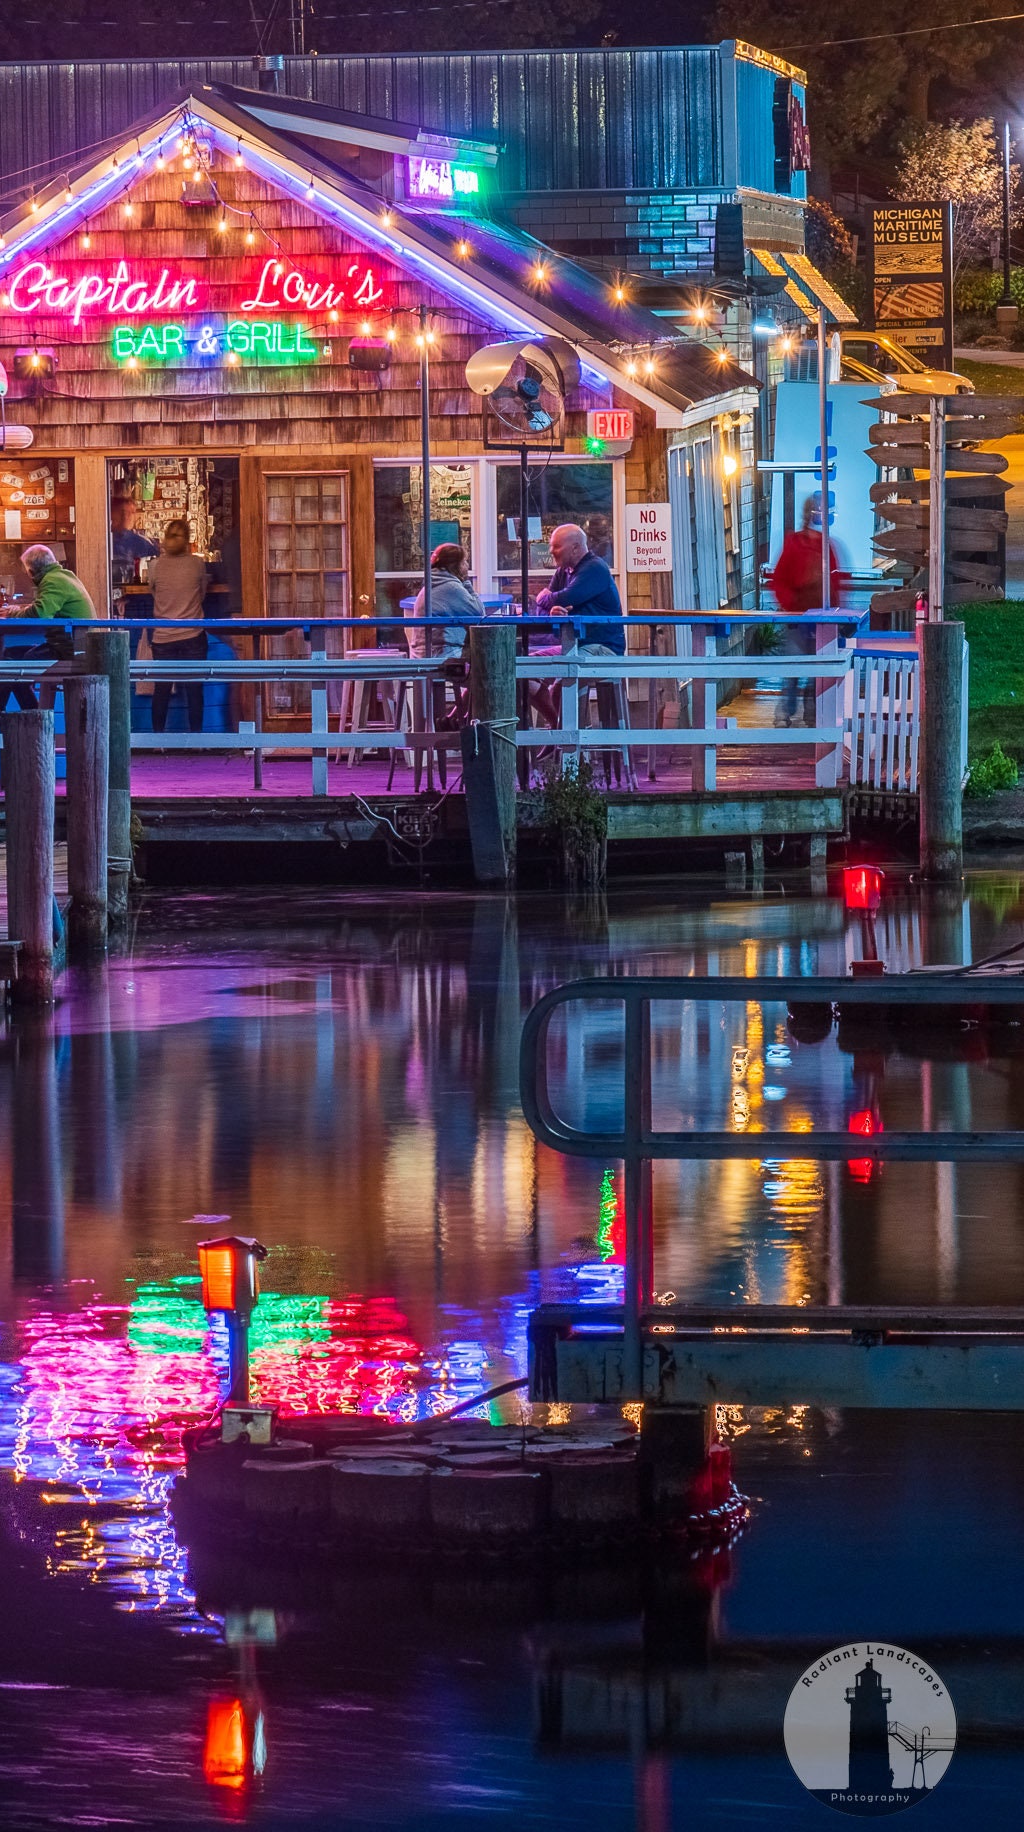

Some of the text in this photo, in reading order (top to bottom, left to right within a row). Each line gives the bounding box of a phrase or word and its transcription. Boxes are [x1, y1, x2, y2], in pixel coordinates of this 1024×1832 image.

[873, 208, 942, 220] MICHIGAN
[873, 220, 943, 231] MARITIME
[873, 231, 943, 243] MUSEUM
[10, 258, 383, 326] Captain Lou's
[115, 321, 315, 356] BAR & GRILL
[596, 413, 627, 438] EXIT
[438, 498, 471, 506] eineke
[640, 510, 656, 523] NO
[630, 529, 667, 542] Drinks
[636, 546, 662, 556] Beyond
[632, 558, 666, 566] This Point
